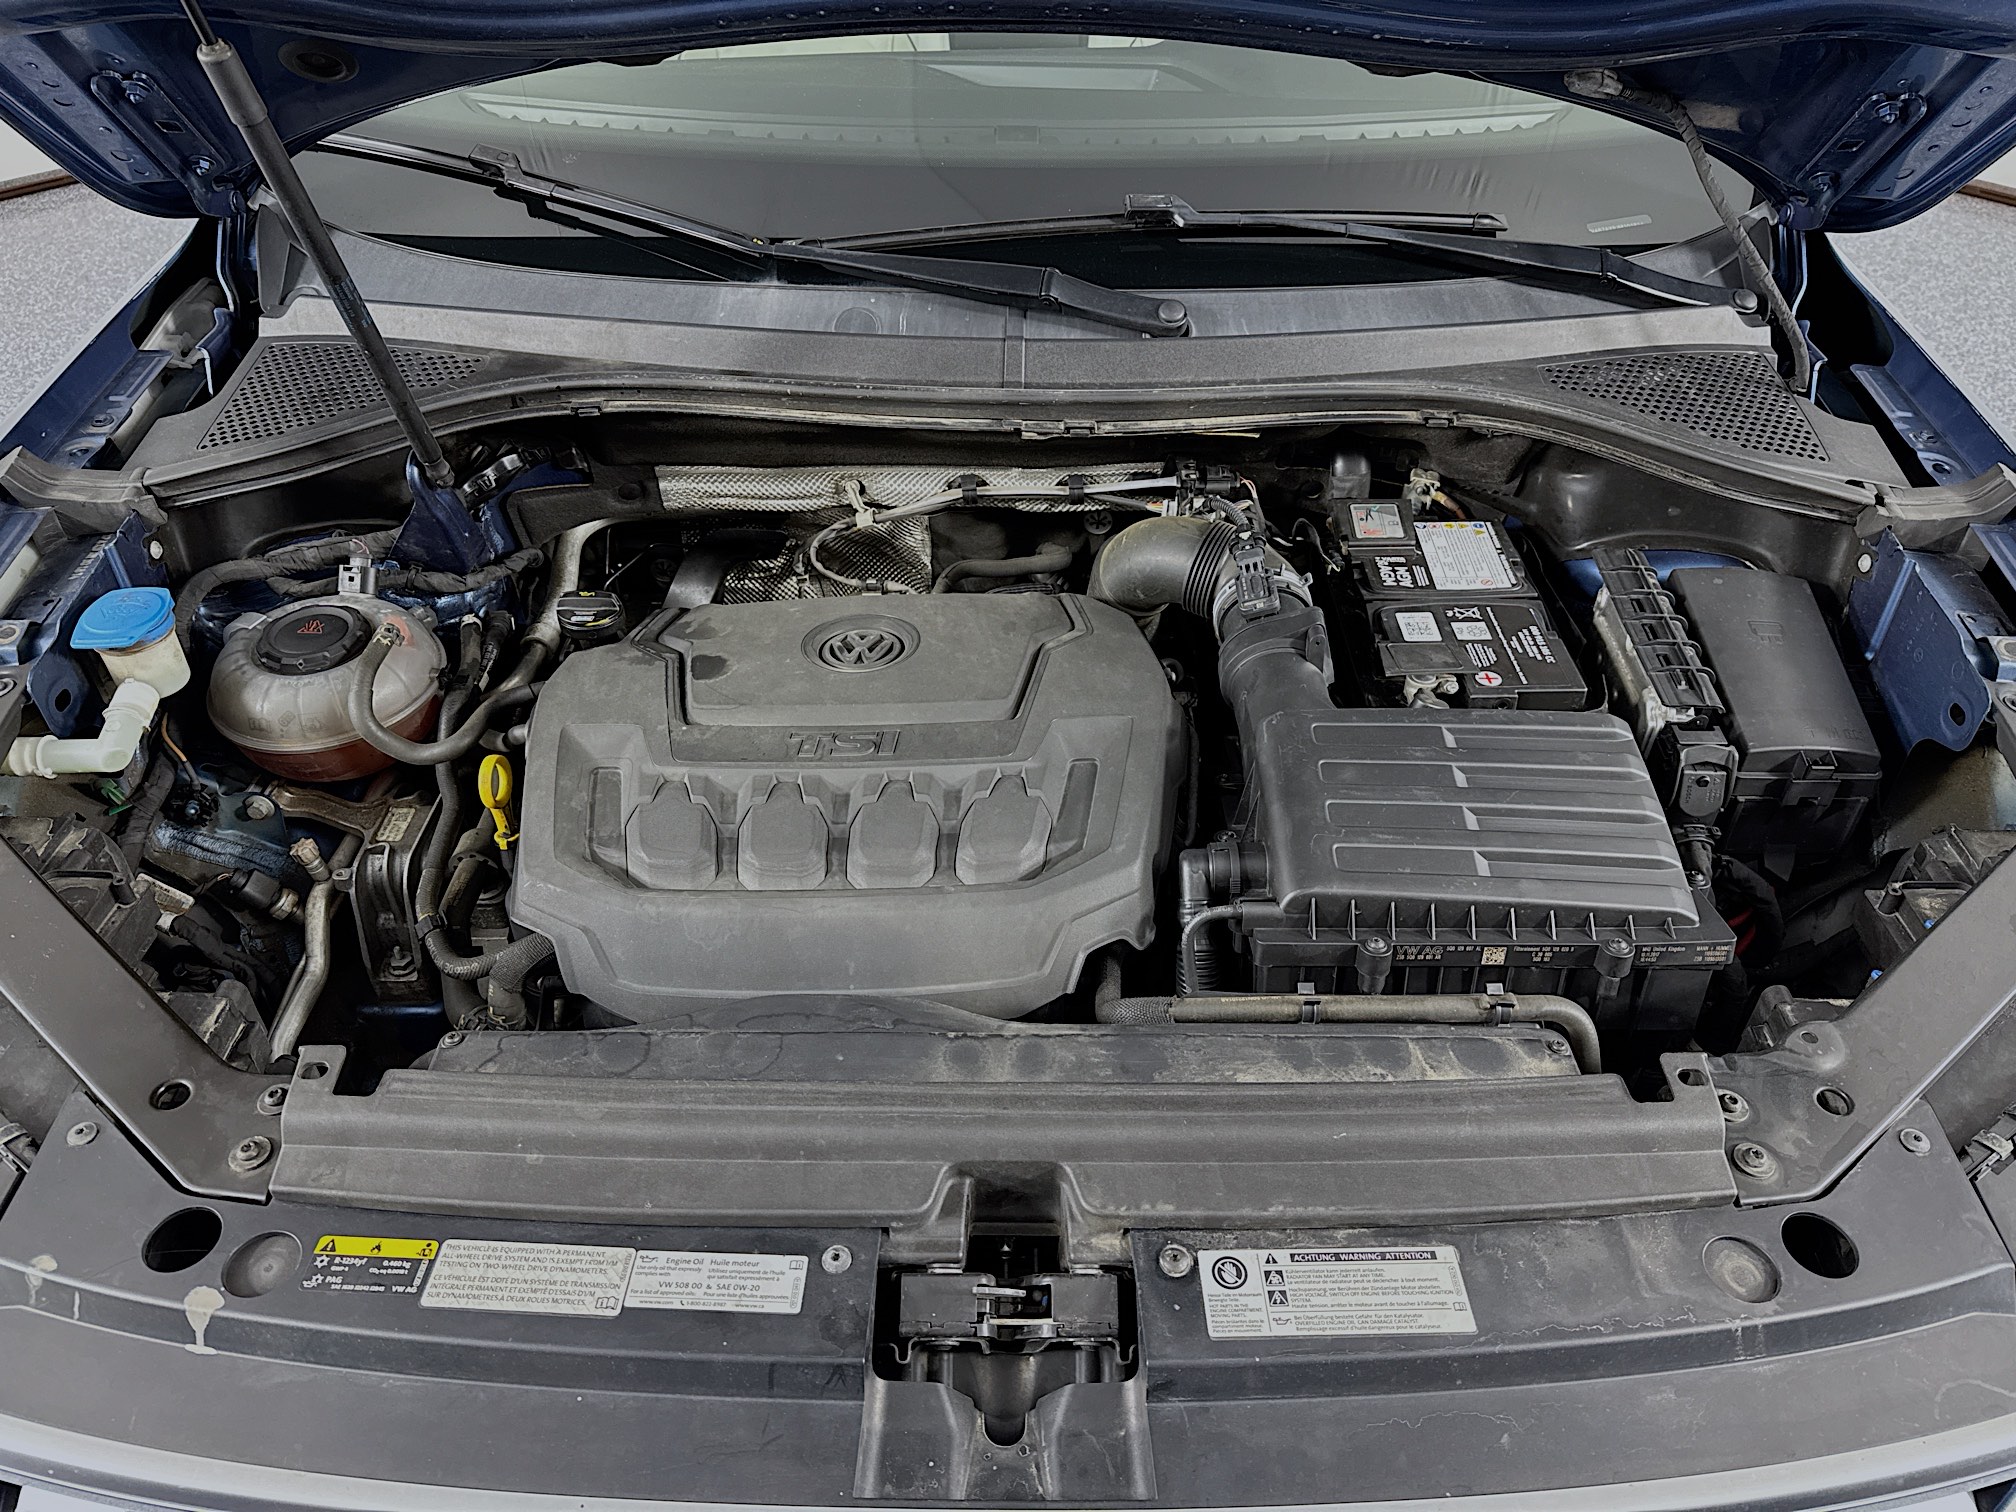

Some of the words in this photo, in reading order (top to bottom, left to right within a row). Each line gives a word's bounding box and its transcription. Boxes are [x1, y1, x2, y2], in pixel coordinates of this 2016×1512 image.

[823, 630, 901, 670] VW
[789, 730, 900, 757] TSI
[1396, 946, 1420, 954] VW
[1422, 946, 1444, 955] AG
[463, 1244, 490, 1252] VEHICLE
[500, 1246, 535, 1254] EQUIPPED
[562, 1249, 606, 1258] PERMANENT
[1294, 1253, 1336, 1261] ACHTUNG
[1340, 1253, 1381, 1261] WARNING
[1385, 1252, 1431, 1260] ATTENTION
[666, 1258, 691, 1266] Engine
[466, 1284, 507, 1292] PERMANENT
[570, 1280, 620, 1289] TRANSMISSION
